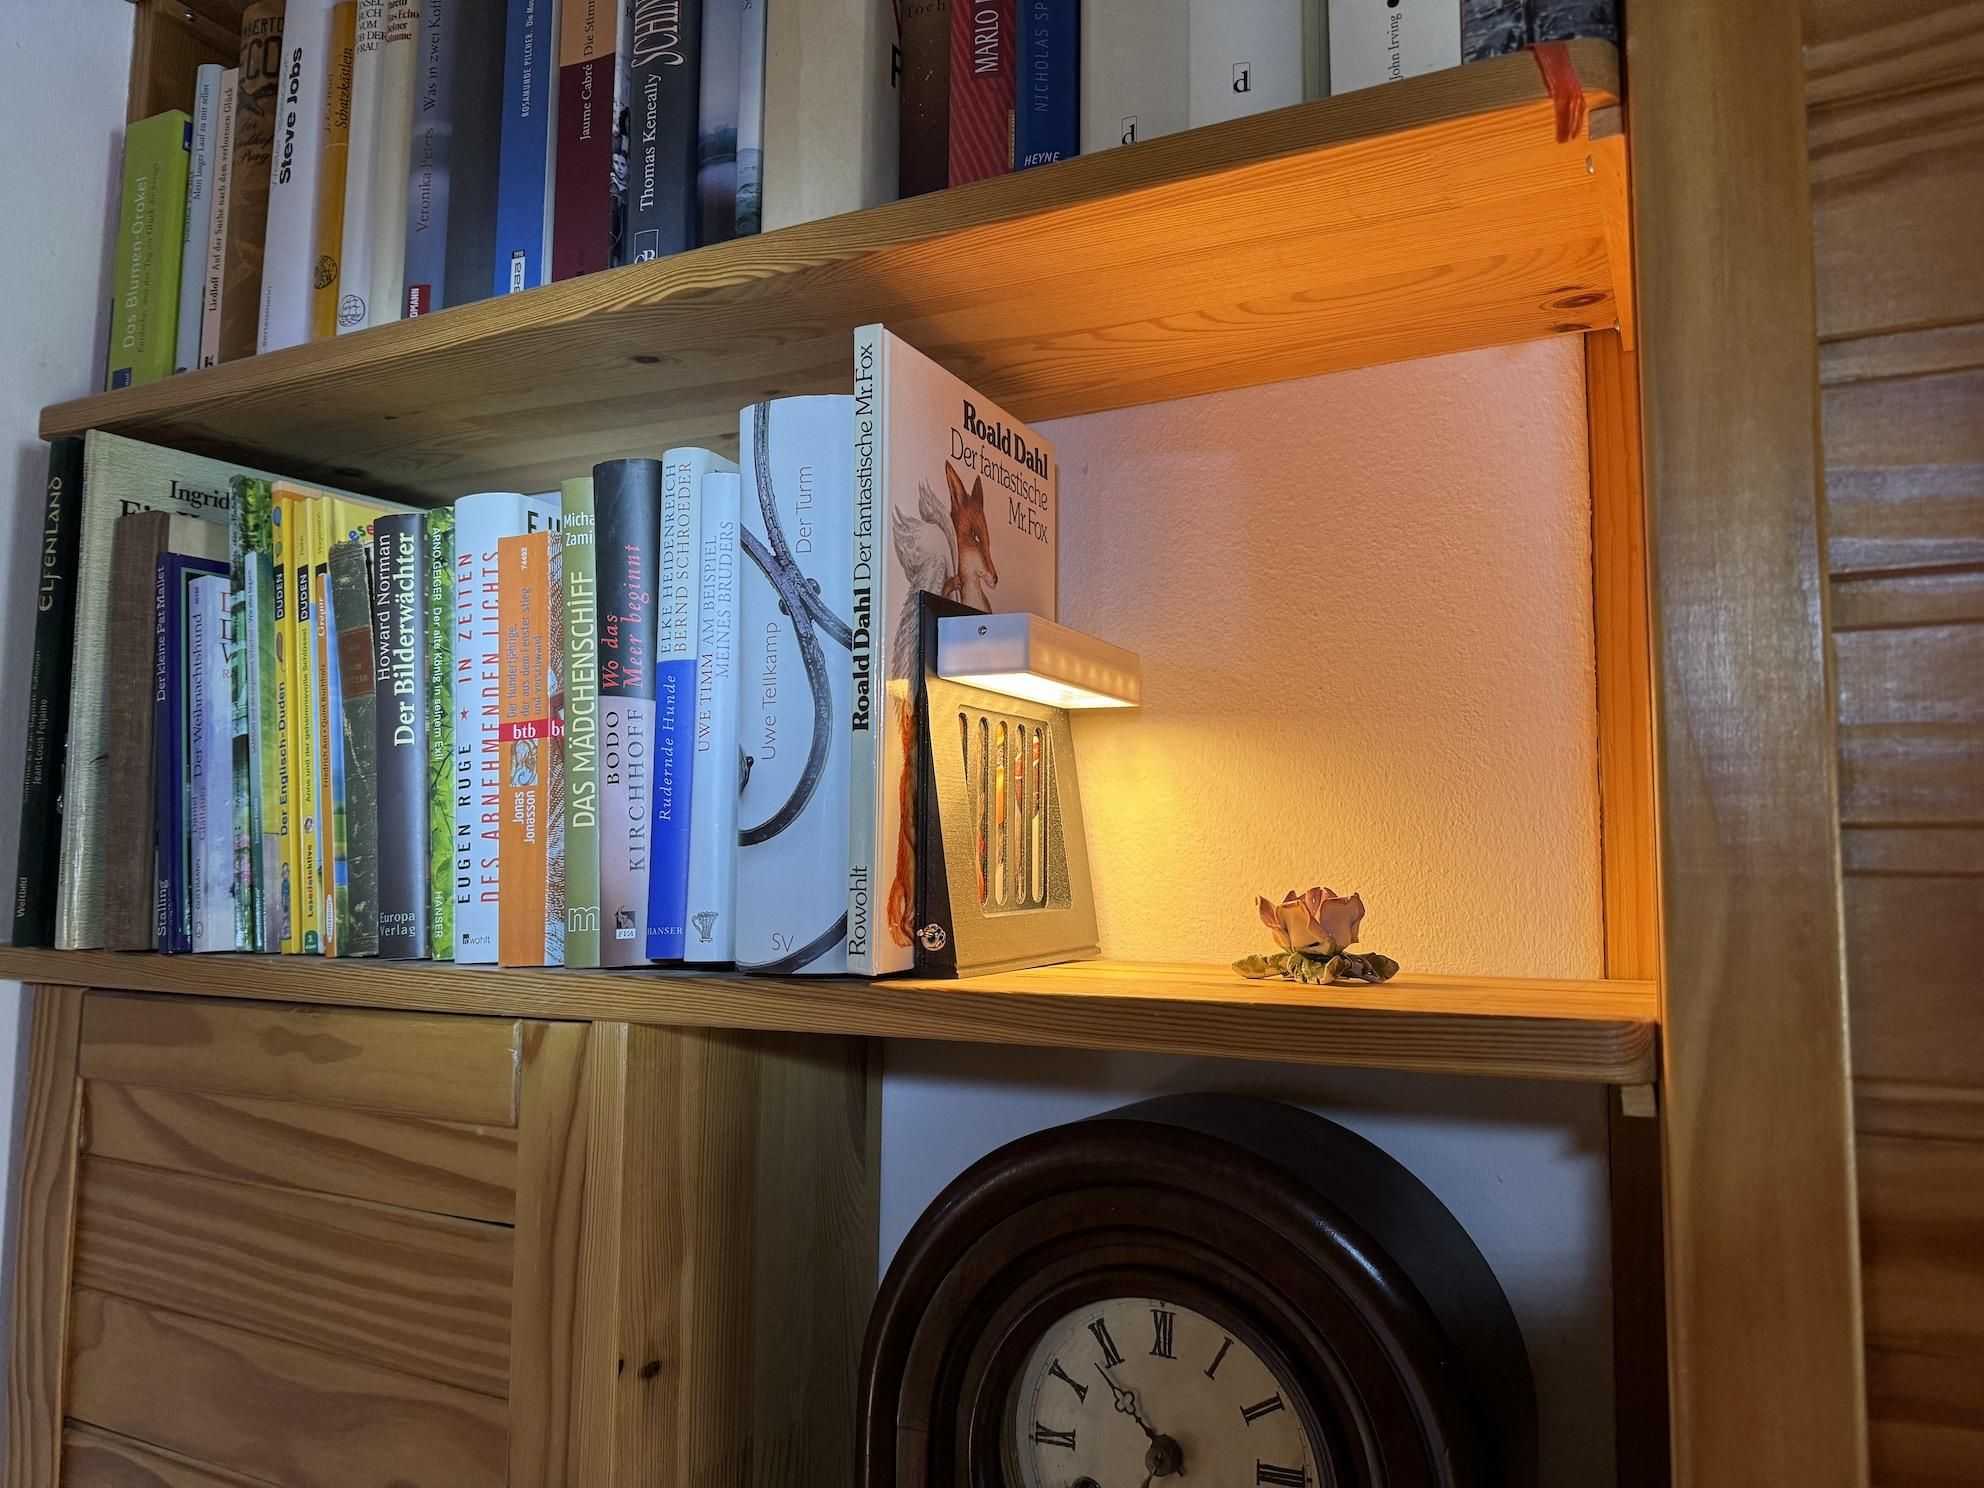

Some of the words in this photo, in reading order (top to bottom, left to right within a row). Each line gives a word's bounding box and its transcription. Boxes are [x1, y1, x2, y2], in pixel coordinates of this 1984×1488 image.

[430, 33, 440, 63] zwei
[583, 35, 594, 56] Die
[1386, 13, 1402, 52] Irving
[286, 47, 303, 105] Jobs
[426, 66, 438, 80] in
[581, 63, 593, 100] Cabré
[1034, 29, 1049, 112] NICHOLAS
[1233, 70, 1250, 93] d
[1387, 53, 1403, 80] John
[200, 84, 210, 105] selbst
[223, 88, 232, 114] Glück
[334, 48, 352, 129] Schatzkästlein
[422, 82, 437, 112] Was
[521, 68, 531, 118] ROSAMUNDE
[642, 73, 662, 144] Keneally
[580, 101, 592, 141] Jaume
[194, 154, 206, 178] langer
[279, 112, 296, 185] Steve
[419, 128, 434, 169] Peters
[1024, 152, 1060, 167] HEYNE
[193, 179, 202, 201] Mein
[218, 163, 227, 182] dem
[639, 146, 655, 211] Thomas
[217, 185, 225, 206] nach
[415, 172, 432, 233] Veronika
[125, 176, 148, 308] Blumen-Orakel
[214, 209, 224, 237] Suche
[211, 254, 221, 271] Auf
[212, 238, 222, 253] der
[209, 276, 219, 312] Liedloff
[123, 314, 137, 348] Das
[963, 399, 1011, 458] Roald
[1014, 432, 1048, 480] Dahl
[795, 465, 813, 511] Turm
[855, 421, 873, 538] fantastische
[950, 426, 978, 470] Der
[980, 444, 1048, 511] fantastische
[168, 479, 230, 511] Ingrid
[661, 464, 676, 599] HEIDENREICH
[675, 461, 691, 580] SCHROEDER
[795, 516, 813, 554] Der
[432, 527, 441, 558] ARNO
[718, 521, 734, 603] BRUDERS
[855, 540, 872, 581] Der
[156, 565, 166, 610] Mallet
[376, 534, 391, 606] Norman
[432, 560, 442, 600] GEIGER
[620, 544, 649, 623] beginnt
[702, 535, 717, 611] BEISPIEL
[276, 573, 284, 619] DUDEN
[300, 573, 309, 620] DUDEN
[392, 531, 415, 696] Bilderwächter
[432, 607, 442, 625] Der
[458, 552, 474, 641] ZEITEN
[520, 587, 532, 613] stieg
[156, 611, 166, 635] Pat
[432, 629, 442, 649] alte
[520, 616, 530, 653] Fenster
[602, 614, 620, 649] das
[660, 606, 673, 654] ELKE
[673, 585, 688, 653] BERND
[701, 619, 715, 647] AM
[851, 587, 870, 650] Dahl
[156, 635, 166, 676] kleine
[301, 628, 309, 672] Schlüssel
[376, 609, 391, 681] Howard
[506, 624, 518, 698] Hundertjährige,
[520, 655, 530, 676] dem
[532, 635, 542, 694] verschwand
[622, 634, 643, 689] Meer
[715, 610, 731, 680] MEINES
[762, 621, 781, 706] Tellkamp
[192, 612, 203, 743] Weihnachtshund
[320, 664, 328, 701] Buchholz
[432, 649, 443, 683] König
[458, 658, 473, 685] IN
[602, 660, 620, 689] Wo
[698, 653, 713, 706] TIMM
[156, 678, 166, 703] Der
[302, 673, 311, 741] geheimnisvolle
[433, 685, 442, 695] in
[520, 700, 530, 717] der
[521, 680, 530, 697] aus
[532, 696, 541, 715] und
[662, 675, 677, 731] Hunde
[851, 652, 870, 731] Roald
[394, 701, 415, 747] Der
[433, 699, 443, 738] seinem
[506, 703, 516, 719] Der
[513, 723, 536, 740] btb
[697, 710, 711, 753] UWE
[278, 681, 289, 806] Englisch-Duden
[434, 740, 444, 760] Exil
[605, 710, 620, 787] BODO
[761, 711, 779, 760] Uwe
[193, 750, 203, 779] Der
[458, 744, 472, 806] RUGE
[658, 737, 674, 821] Rudernde
[511, 791, 524, 825] Jonas
[572, 780, 596, 828] DAS
[627, 709, 646, 873] KIRCHHOFF
[279, 809, 288, 836] Der
[523, 790, 536, 845] Jonasson
[306, 844, 314, 918] Lesedetektive
[457, 823, 471, 904] EUGEN
[15, 877, 28, 917] Weltbild
[157, 879, 169, 937] Stalling
[433, 890, 444, 939] HANSER
[848, 865, 870, 957] Rowohlt
[379, 912, 415, 925] Europa
[379, 923, 416, 937] Verlag
[647, 925, 683, 936] HANSER
[771, 932, 794, 953] SV
[1087, 1317, 1126, 1369] XI
[1149, 1309, 1177, 1360] XII
[1240, 1391, 1285, 1427] II
